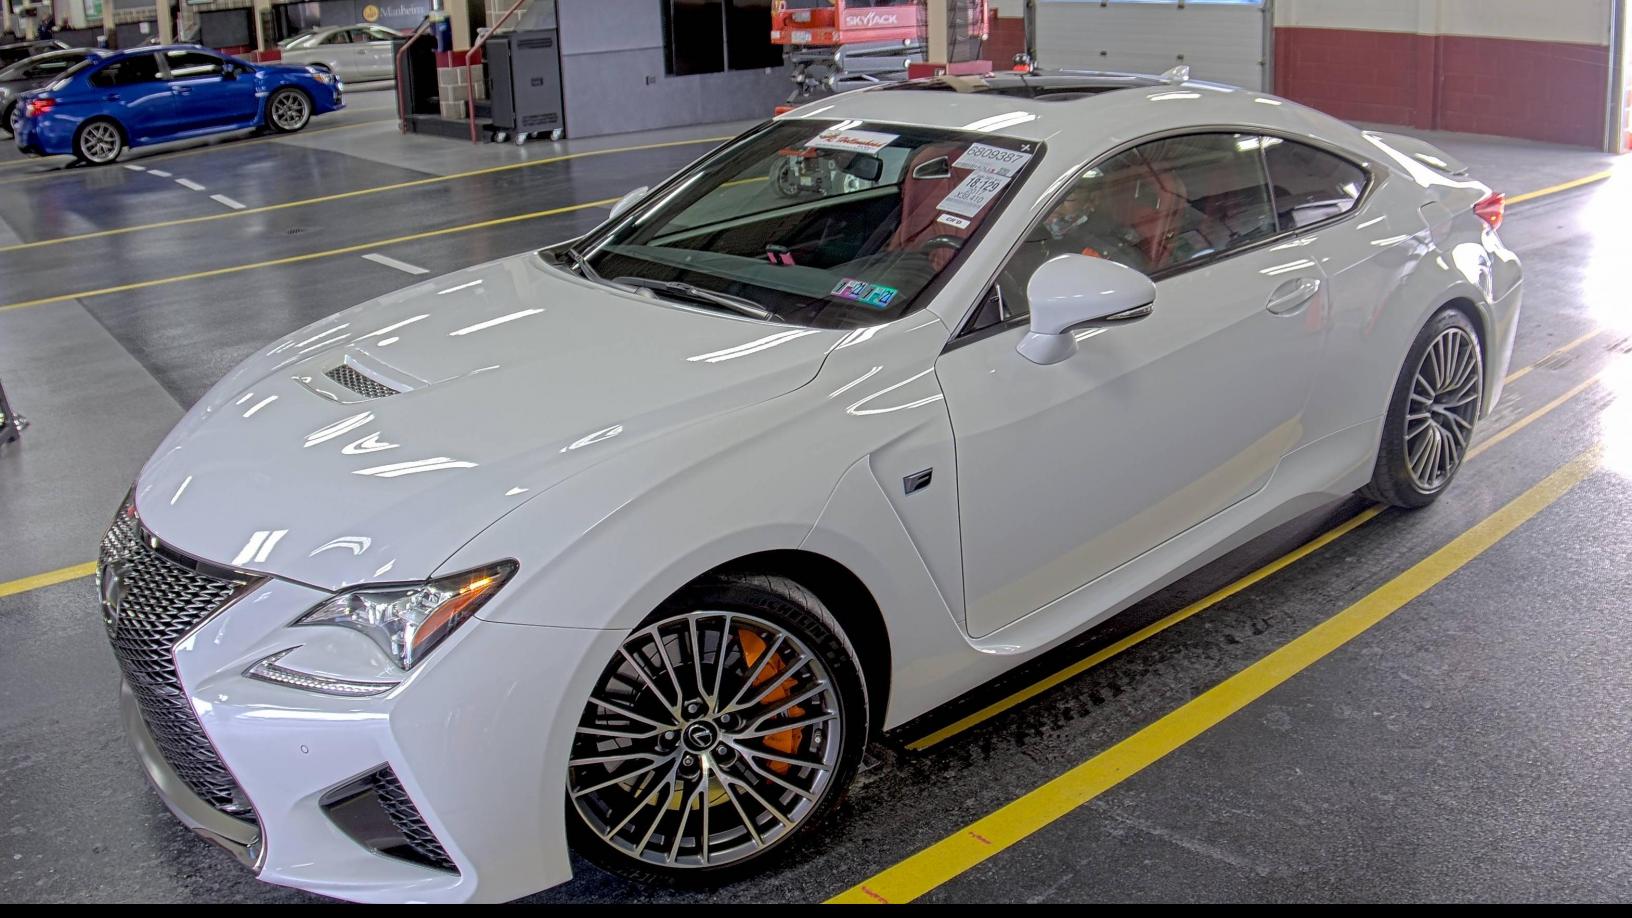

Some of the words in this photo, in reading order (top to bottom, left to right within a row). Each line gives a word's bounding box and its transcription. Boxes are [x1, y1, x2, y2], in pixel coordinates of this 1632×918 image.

[380, 3, 425, 17] Manheim
[846, 11, 898, 26] SKYJACK
[967, 145, 1023, 164] 6809387
